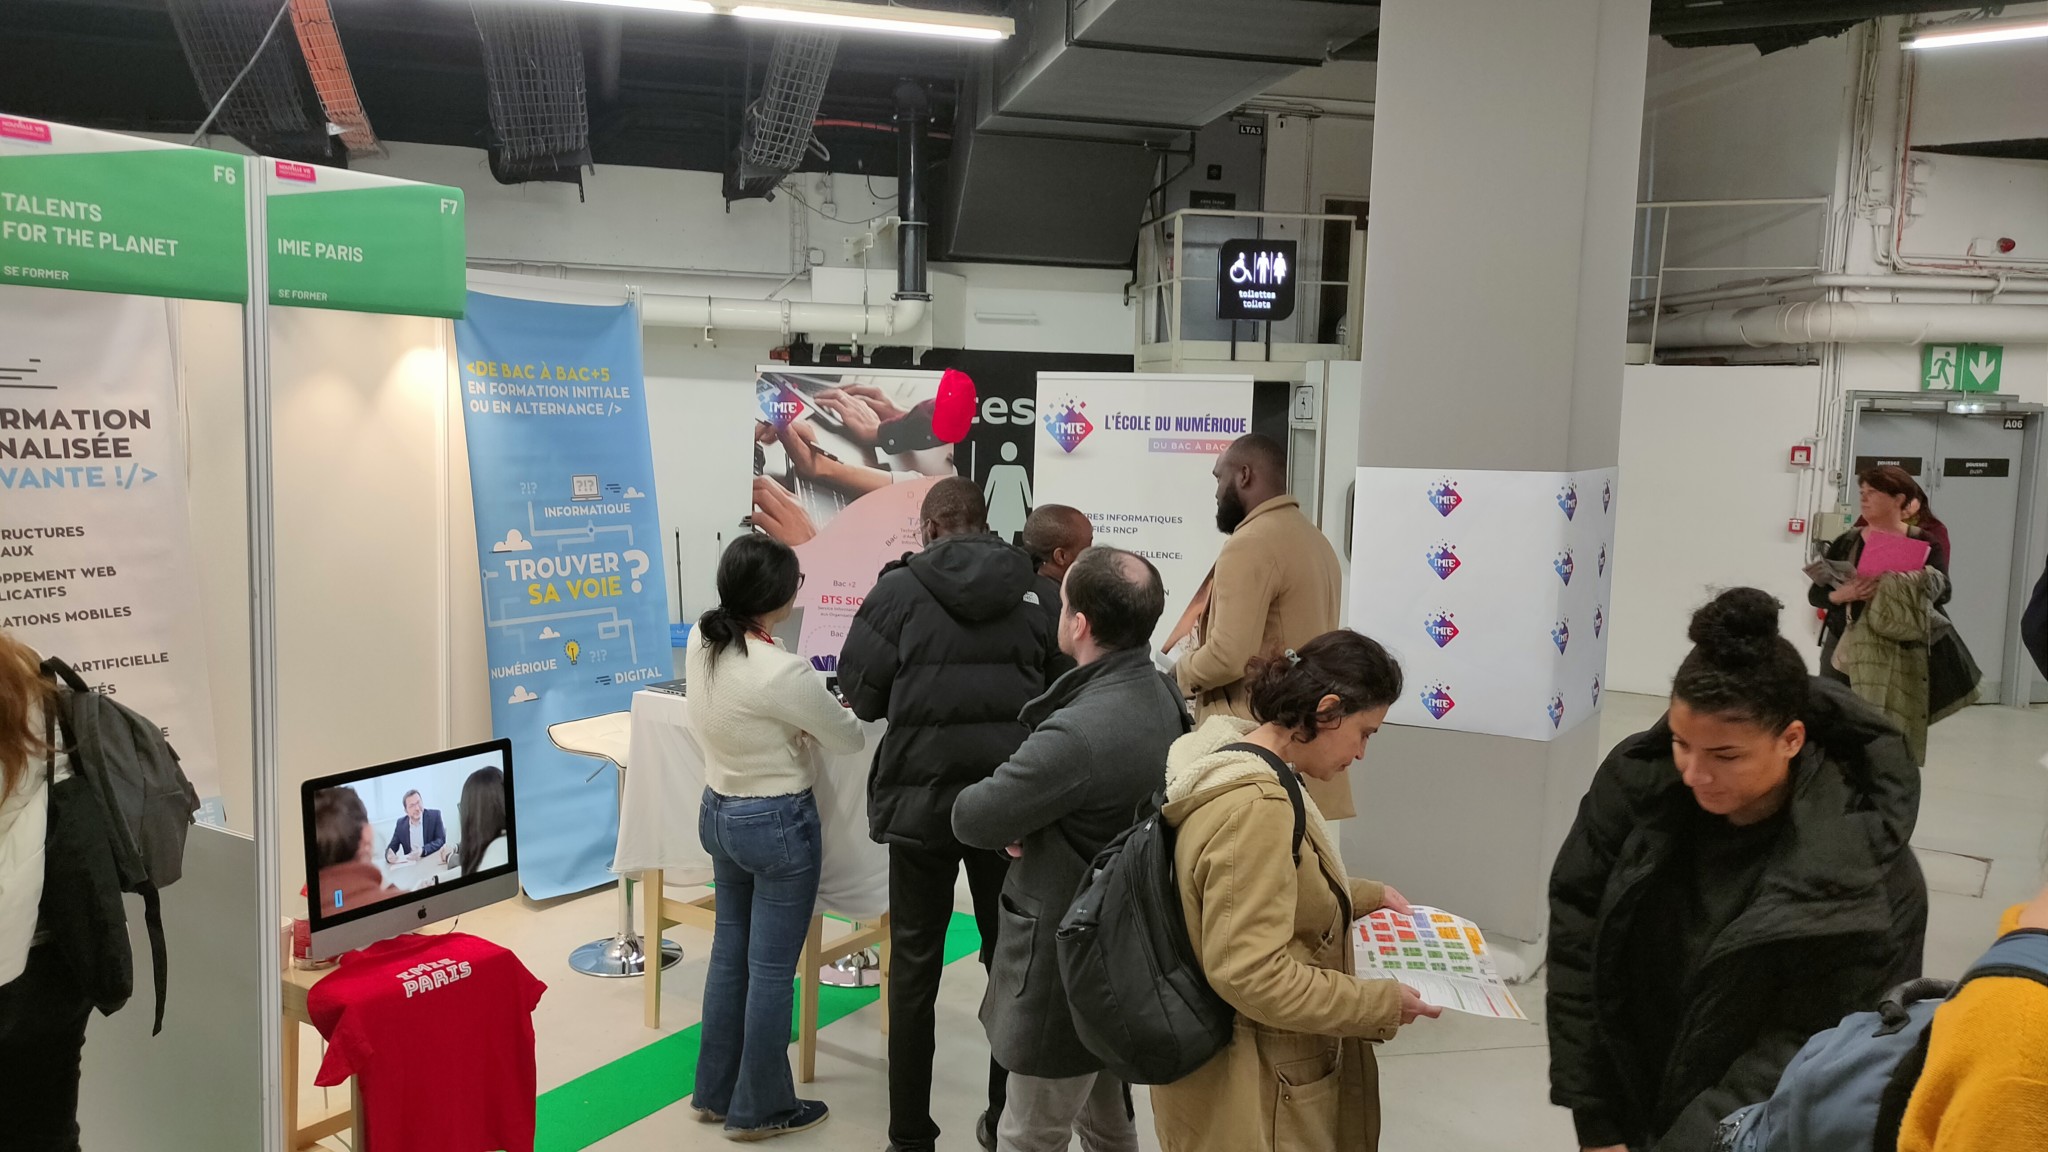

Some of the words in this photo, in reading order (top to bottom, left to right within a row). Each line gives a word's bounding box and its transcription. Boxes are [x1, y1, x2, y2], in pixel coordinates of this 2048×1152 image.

[1240, 126, 1262, 135] LTA3
[213, 165, 236, 185] F6
[1, 192, 102, 222] TALENTS
[440, 198, 458, 215] F7
[3, 221, 48, 243] FOR
[52, 226, 94, 248] THE
[99, 232, 178, 257] PLANET
[277, 238, 311, 257] IMIE
[315, 244, 363, 263] PARIS
[4, 265, 20, 277] SE
[22, 267, 69, 280] FORMER
[278, 288, 291, 299] SE
[292, 290, 328, 302] FORMER
[1238, 289, 1276, 299] toilettes
[1243, 299, 1271, 309] toilets
[502, 363, 535, 379] BAC
[540, 361, 552, 380] À
[556, 366, 610, 382] BAC+5
[468, 381, 486, 394] EN
[490, 382, 569, 398] FORMATION
[572, 386, 630, 399] INITIALE
[470, 400, 489, 413] OU
[493, 401, 511, 414] EN
[514, 401, 604, 415] ALTERNANCE
[769, 401, 797, 414] IMIE
[0, 408, 151, 430] RMATION
[1105, 412, 1150, 431] L'ÉCOLE
[1155, 416, 1171, 432] DU
[1175, 413, 1247, 434] NUMÉRIQUE
[2005, 419, 2023, 429] A06
[1055, 422, 1086, 435] IMIE
[0, 432, 132, 459] NALISÉE
[1153, 441, 1167, 450] DU
[1171, 442, 1191, 451] BAC
[0, 466, 106, 489] VANTE
[544, 503, 631, 518] INFORMATIQUE
[1106, 513, 1183, 524] INFORMATIQUES
[1, 526, 85, 540] RUCTURES
[1113, 526, 1138, 534] RNCP
[1, 545, 34, 557] AUX
[0, 568, 76, 584] PPEMENT
[80, 566, 117, 579] WEB
[505, 552, 619, 581] TROUVER
[622, 550, 650, 593] ?
[528, 583, 561, 605] SA
[566, 576, 622, 600] VOIE
[821, 595, 842, 605] BTS
[0, 612, 62, 628] ATIONS
[65, 606, 132, 622] MOBILES
[72, 652, 169, 673] ARTIFICIELLE
[491, 659, 557, 679] NUMÉRIQUE
[615, 667, 662, 684] DIGITAL
[402, 961, 472, 998] PARIS
